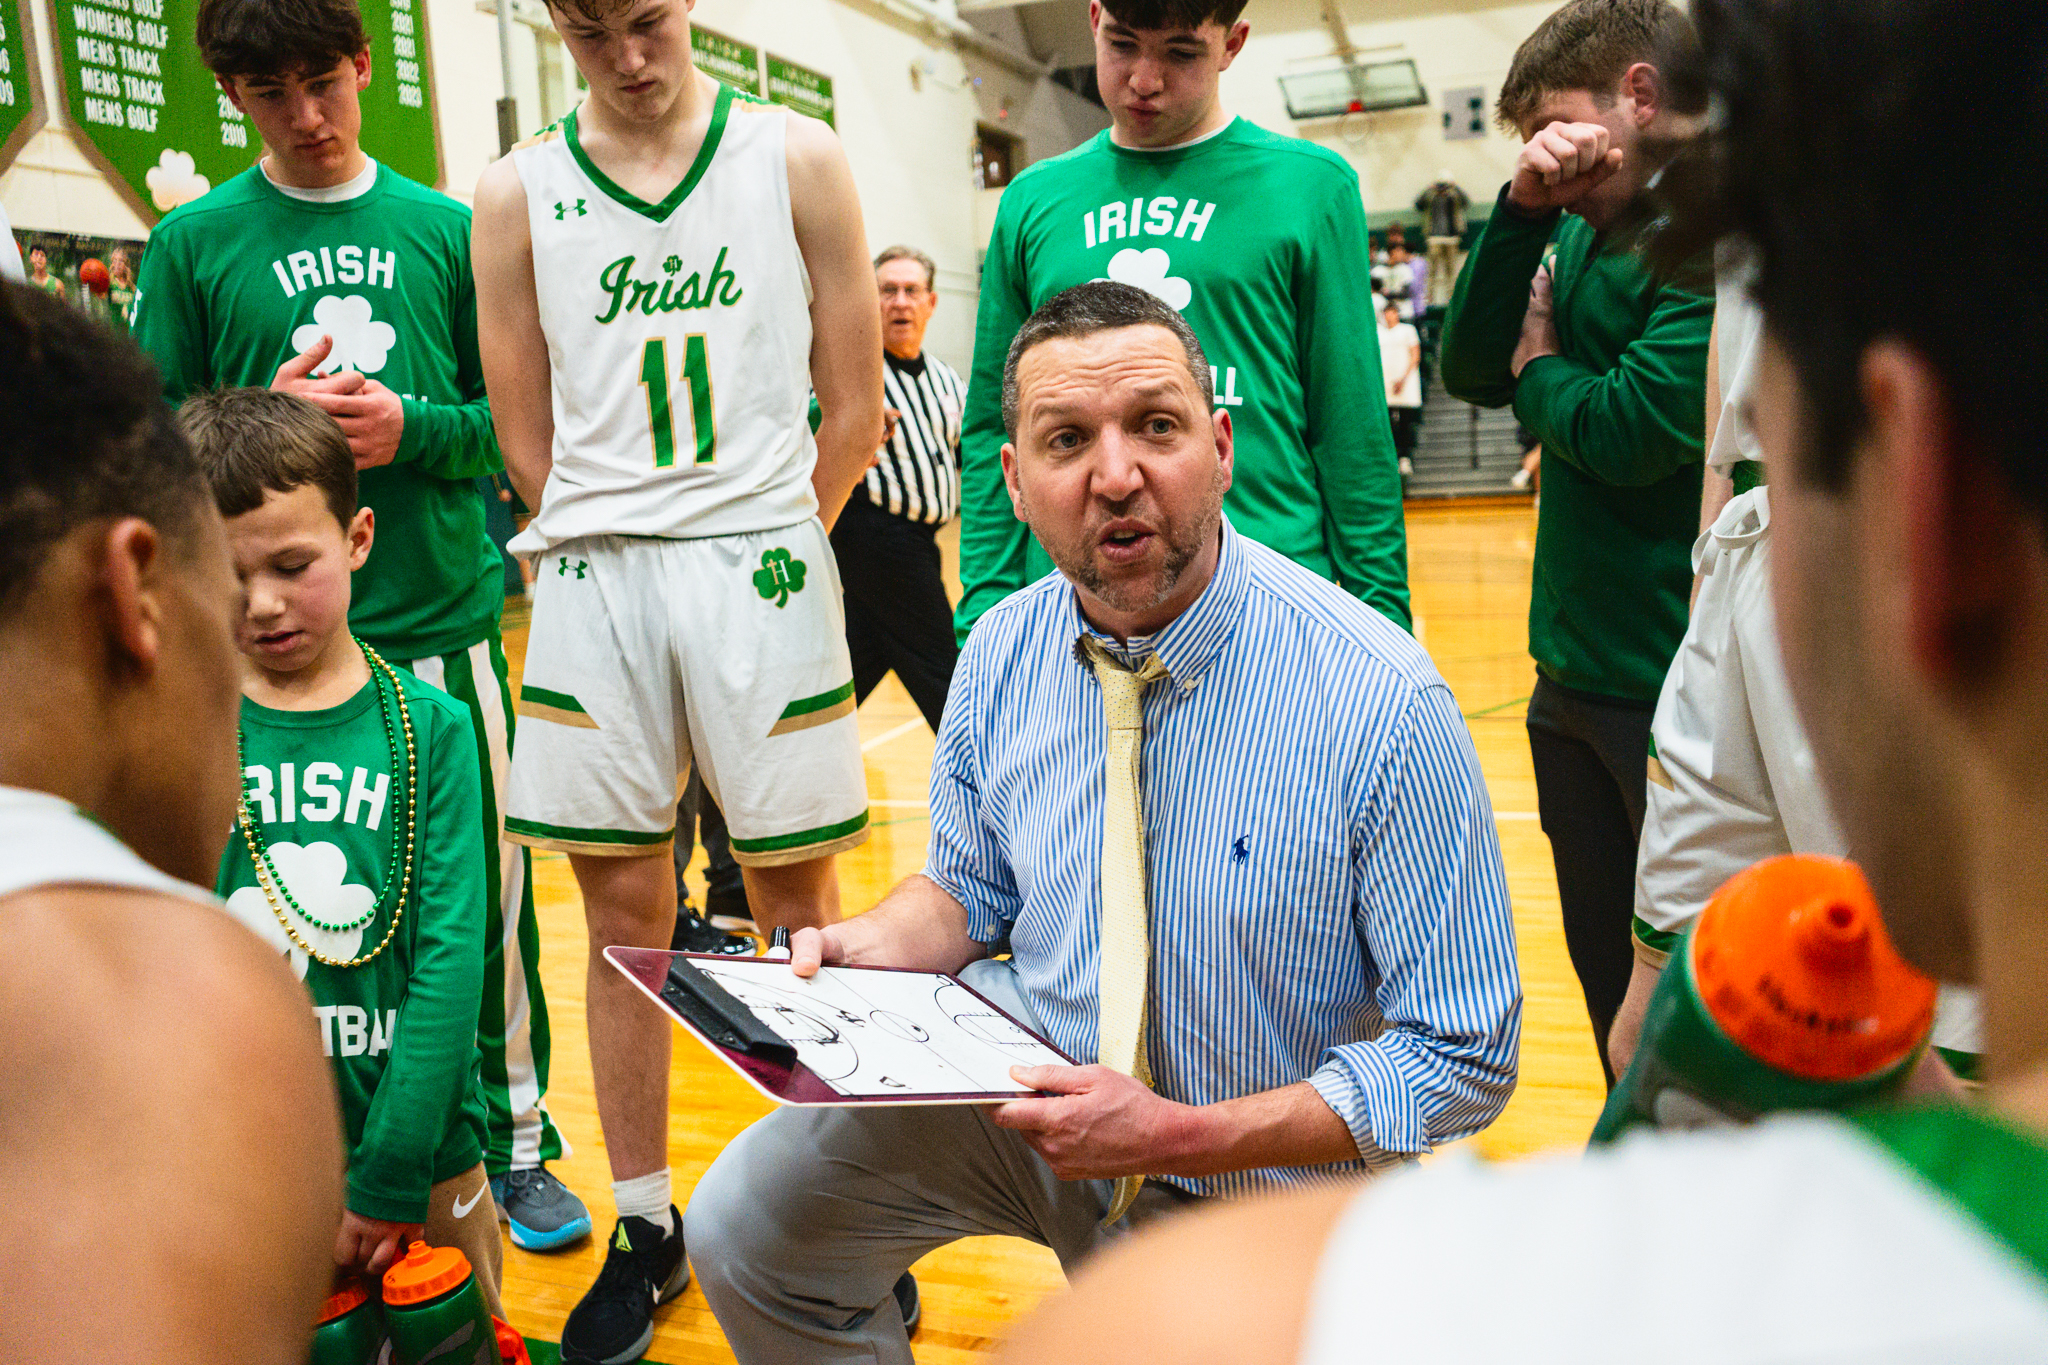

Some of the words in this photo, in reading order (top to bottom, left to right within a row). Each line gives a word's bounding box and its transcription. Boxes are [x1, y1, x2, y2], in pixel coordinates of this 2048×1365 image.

[73, 4, 134, 42] WOMENS
[136, 20, 169, 49] GOLF
[76, 36, 117, 67] MENS
[118, 44, 161, 77] TRACK
[81, 66, 121, 98] MENS
[122, 74, 165, 106] TRACK
[84, 96, 124, 128] MENS
[126, 104, 159, 133] GOLF
[1083, 196, 1217, 249] IRISH
[272, 245, 396, 299] IRISH
[594, 246, 743, 325] Irish
[637, 332, 718, 471] 11
[229, 761, 391, 833] RISH
